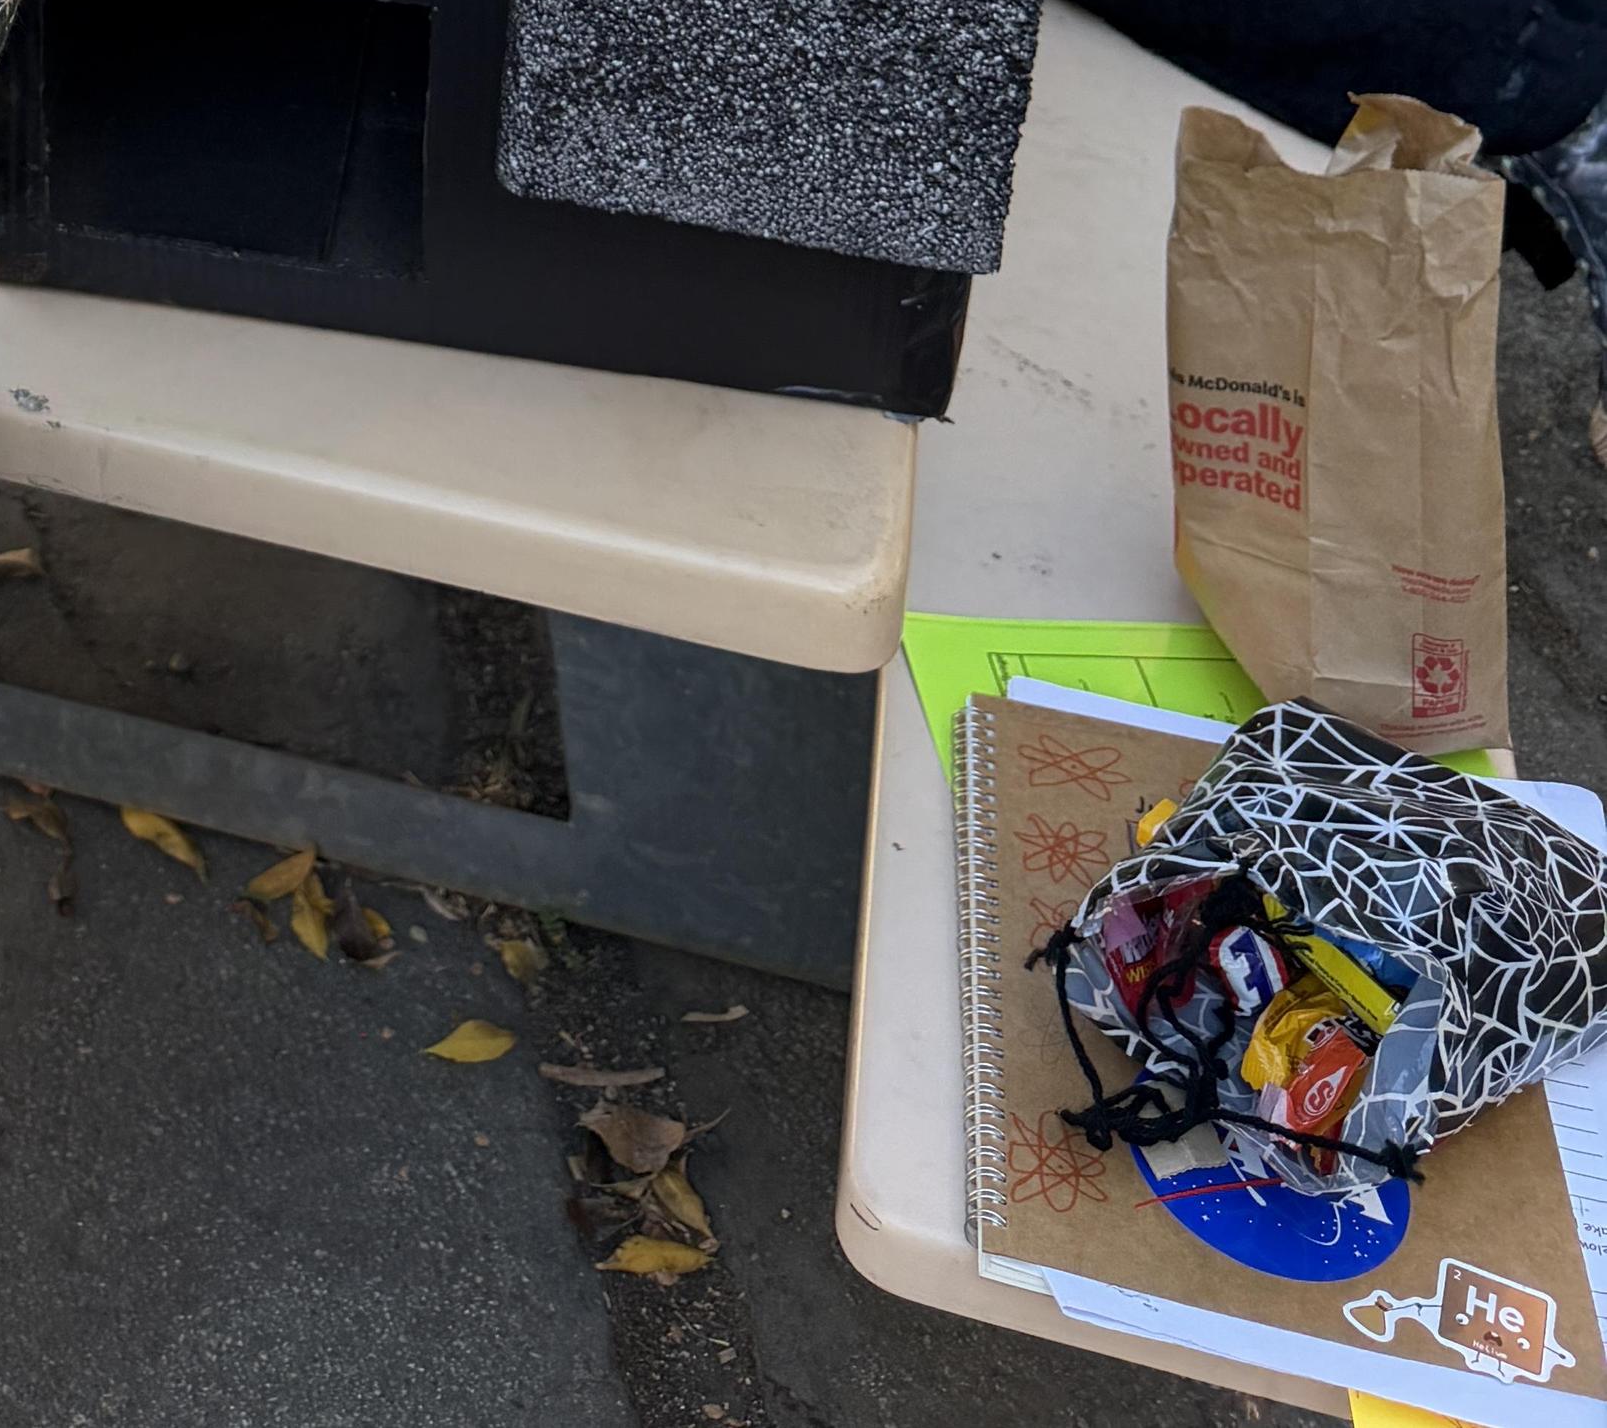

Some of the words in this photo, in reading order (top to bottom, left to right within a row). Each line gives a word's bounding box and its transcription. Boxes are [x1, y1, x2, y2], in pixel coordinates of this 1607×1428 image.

[1188, 374, 1291, 402] McDonald's
[1171, 401, 1303, 458] ocally
[1173, 433, 1250, 464] wned
[1258, 450, 1302, 482] and
[1175, 456, 1302, 511] perated
[1453, 1269, 1462, 1281] 2
[1465, 1284, 1525, 1333] He
